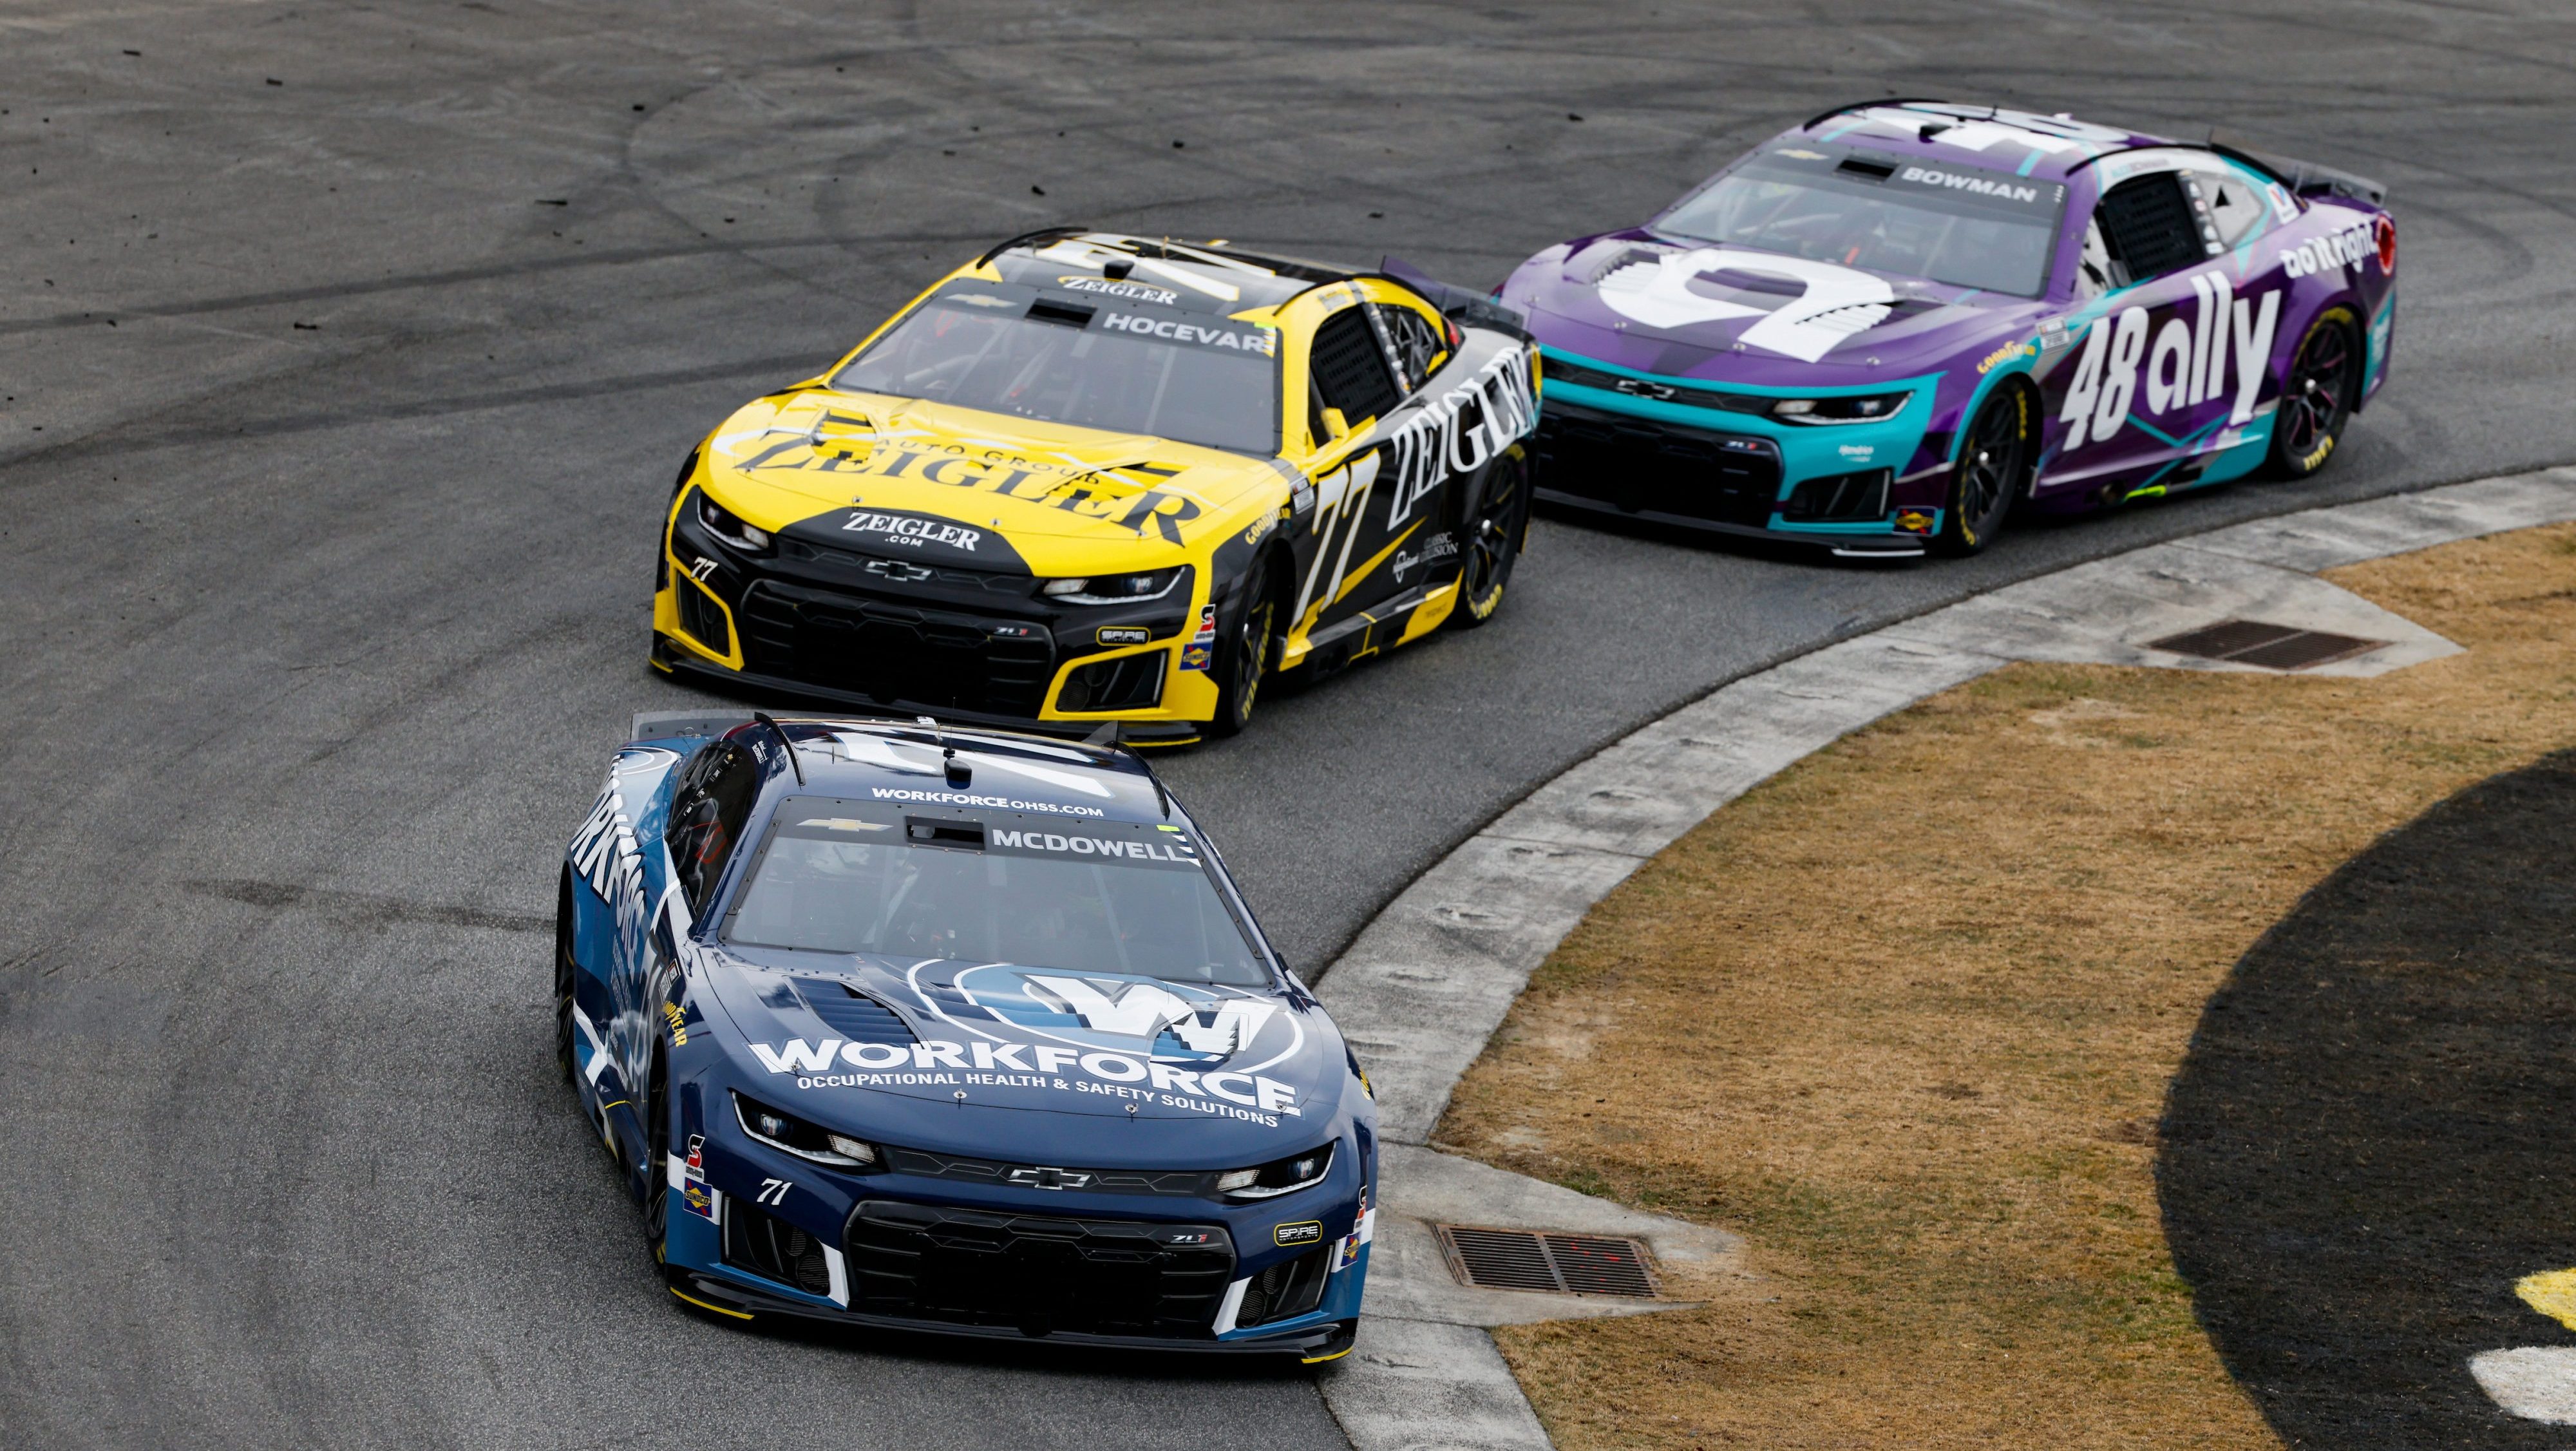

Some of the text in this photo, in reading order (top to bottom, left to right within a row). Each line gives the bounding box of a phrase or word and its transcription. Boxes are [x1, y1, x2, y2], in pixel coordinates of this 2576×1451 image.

[1902, 167, 2038, 202] BOWMAN
[1063, 278, 1178, 305] ZEIGLER
[1103, 313, 1265, 353] HOCEVAR
[2059, 270, 2282, 451] 48 ally
[877, 439, 965, 455] AUTO
[732, 430, 1202, 548] ZEIGLER
[842, 512, 980, 552] ZEIGLER
[885, 535, 923, 547] .COM
[1288, 447, 1381, 630] 77
[690, 556, 718, 582] 77
[992, 830, 1191, 862] MCDOWELL
[747, 1038, 1302, 1117] WORKFORCE
[797, 1073, 1279, 1128] OCCUPATIONAL HEALTH & SAFETY SOLUTIONS
[685, 1191, 711, 1206] SUNOCO
[757, 1178, 793, 1205] 71
